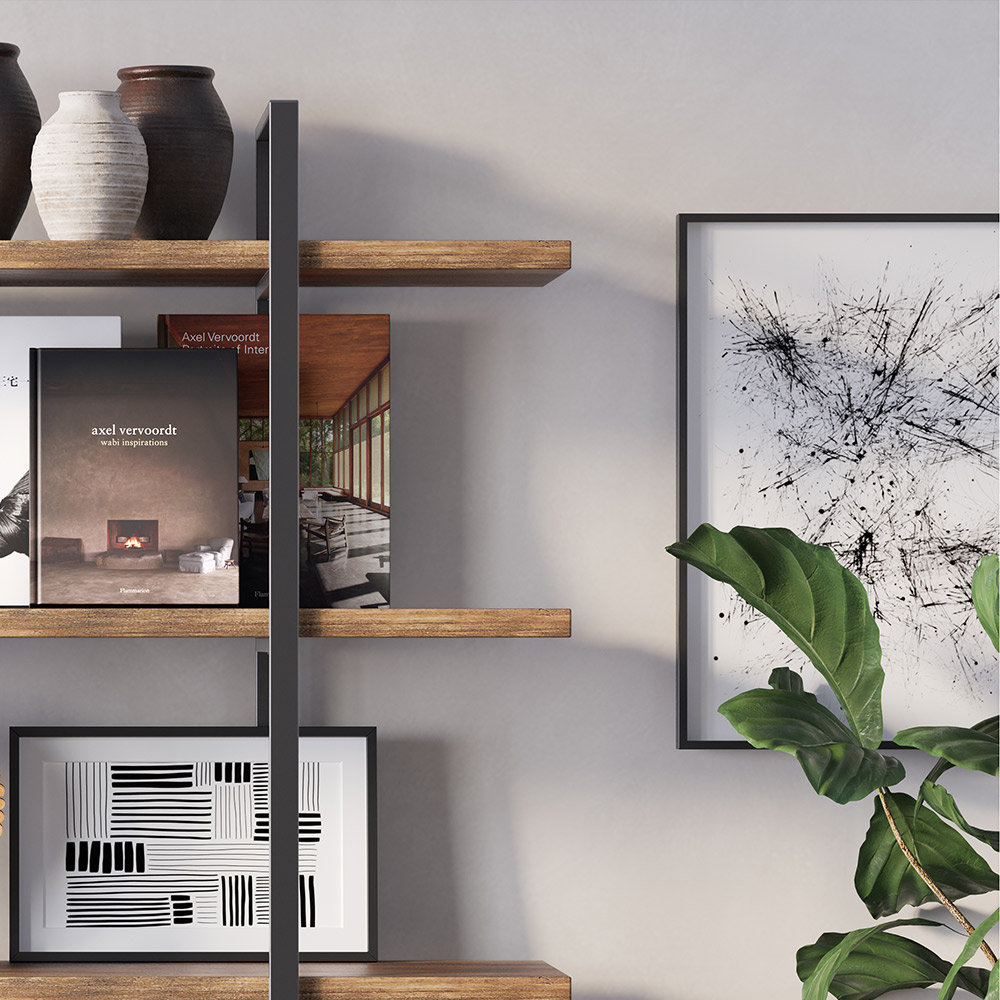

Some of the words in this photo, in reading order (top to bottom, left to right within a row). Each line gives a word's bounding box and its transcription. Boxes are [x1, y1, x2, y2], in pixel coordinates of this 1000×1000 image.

[182, 332, 205, 342] Axel
[208, 332, 260, 342] Vervoordt
[91, 424, 116, 435] axel
[119, 424, 177, 435] vervoordt
[100, 438, 120, 447] wabi
[122, 438, 168, 448] inspirations
